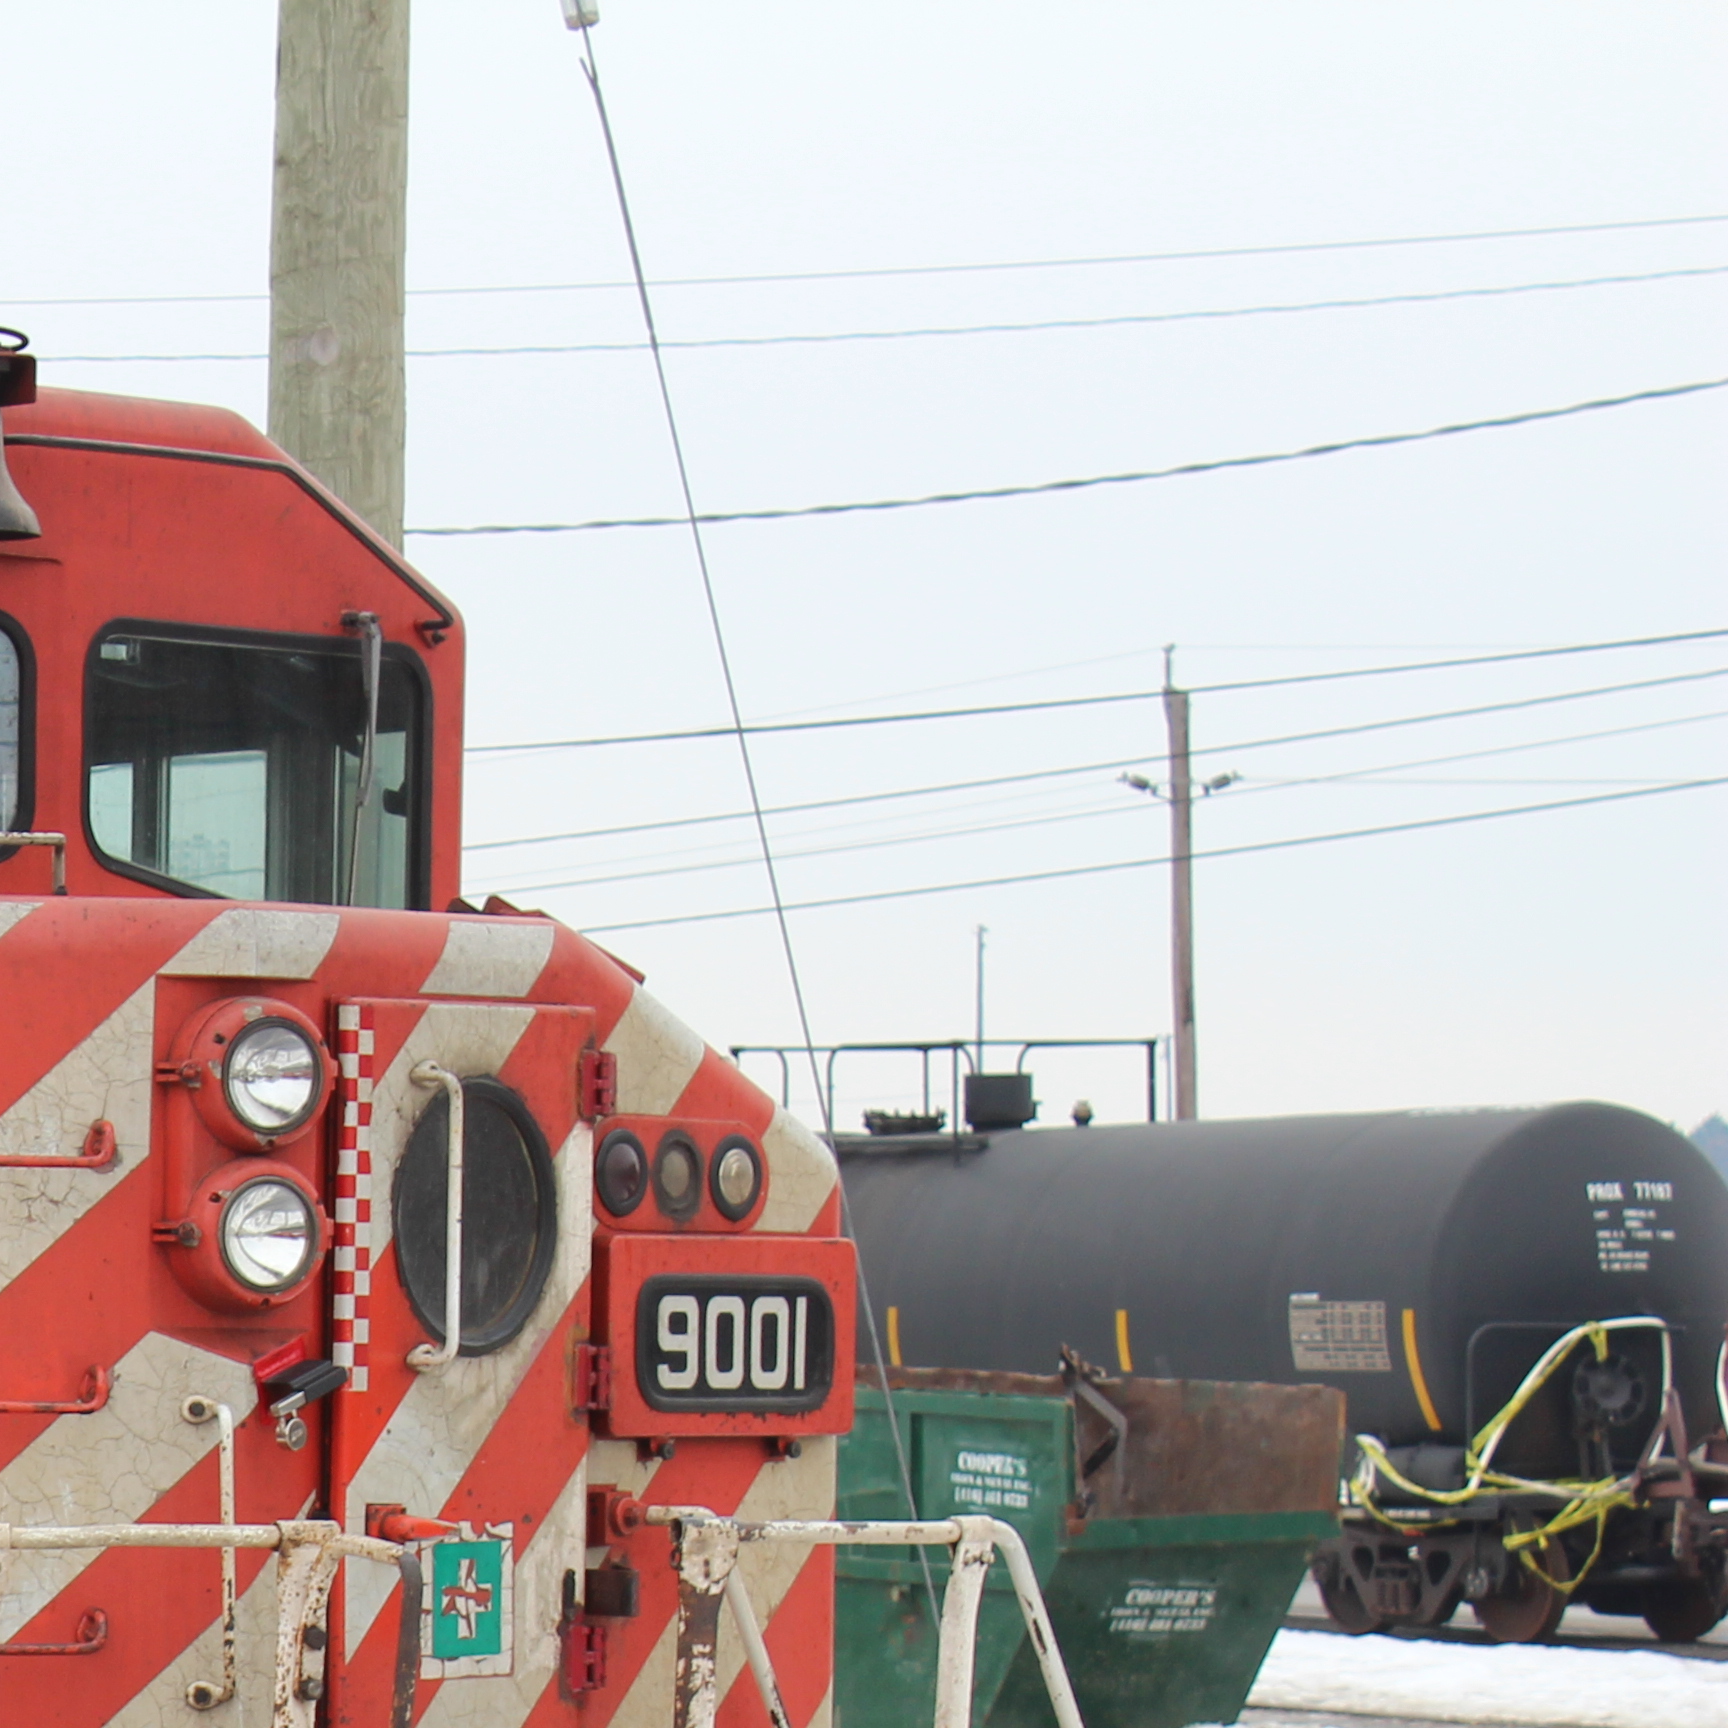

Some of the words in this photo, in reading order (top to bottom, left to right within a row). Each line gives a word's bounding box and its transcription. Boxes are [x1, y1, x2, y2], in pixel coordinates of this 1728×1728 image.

[1586, 1181, 1624, 1201] PROX
[656, 1295, 808, 1391] 9001
[957, 1451, 1028, 1477] COOPER'S
[1125, 1588, 1216, 1606] COOPER'S
